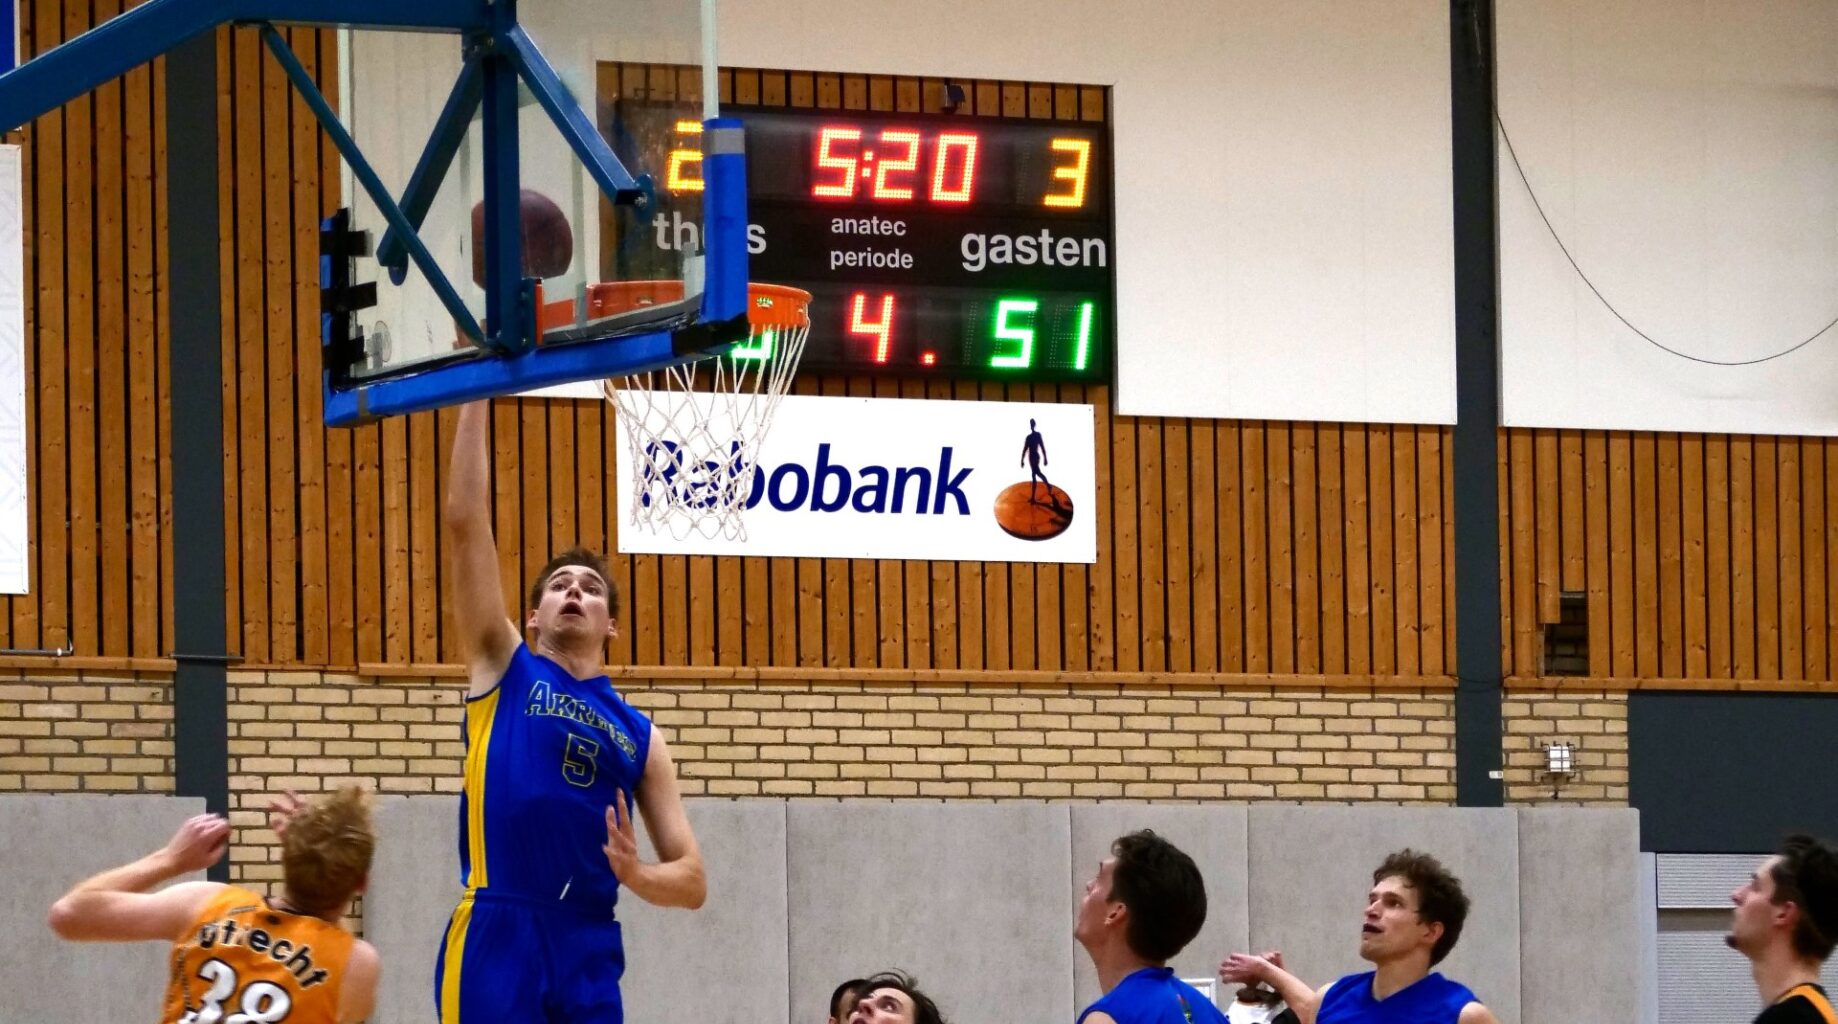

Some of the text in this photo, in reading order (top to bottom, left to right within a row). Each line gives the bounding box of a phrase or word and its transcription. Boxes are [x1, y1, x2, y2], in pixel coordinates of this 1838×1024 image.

[812, 128, 978, 202] 5:20
[1044, 138, 1092, 207] 3
[652, 211, 767, 254] ths
[831, 216, 907, 237] anatec
[961, 229, 1107, 271] gasten
[830, 248, 913, 269] periode
[991, 300, 1093, 370] 51
[642, 439, 974, 515] Rabobank
[562, 732, 599, 788] 5
[199, 919, 328, 988] utecht
